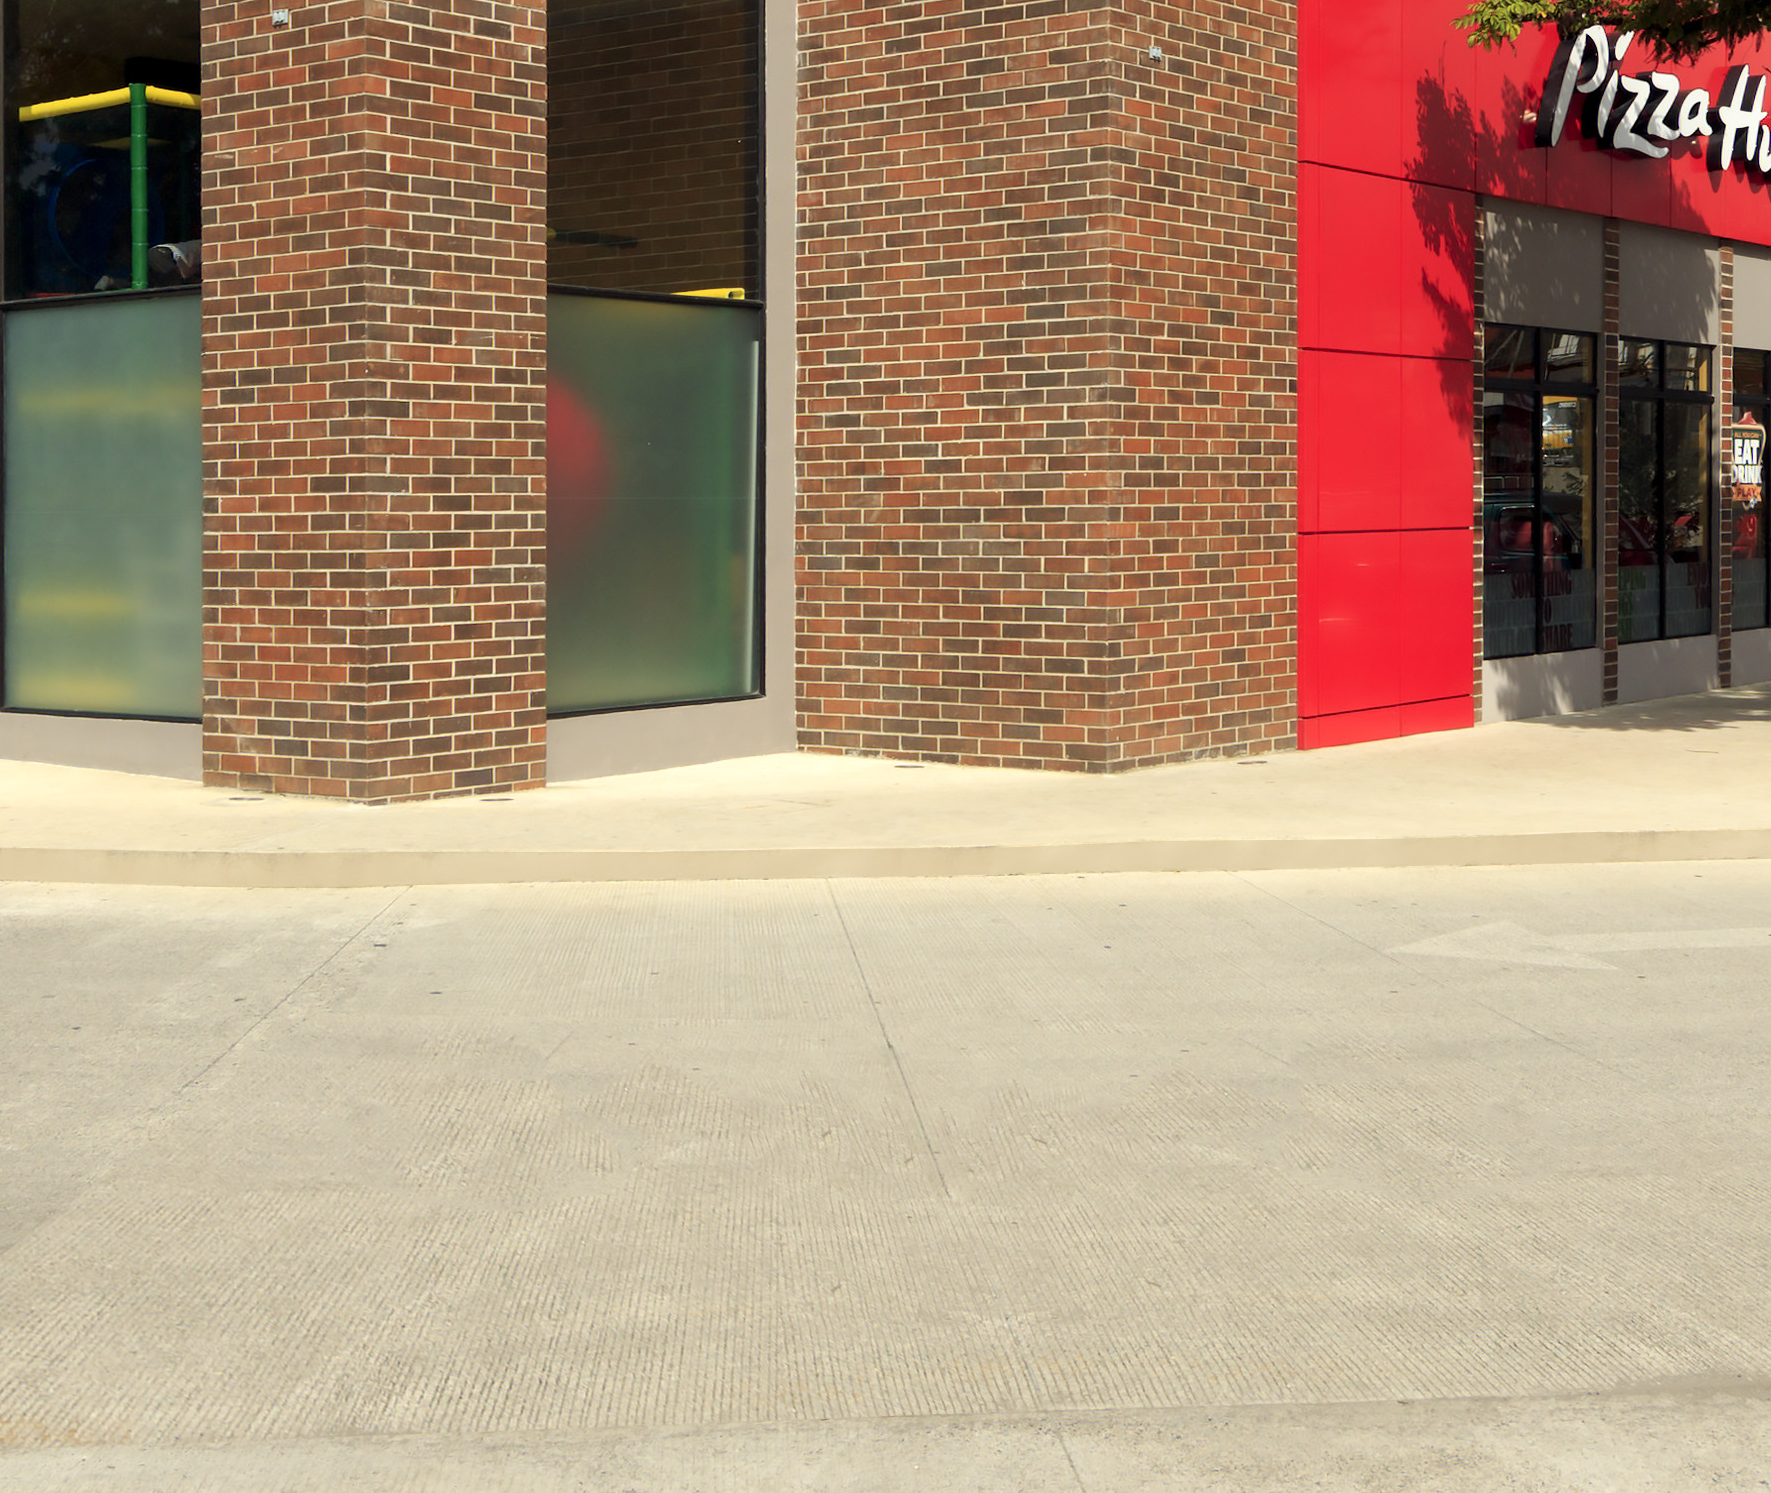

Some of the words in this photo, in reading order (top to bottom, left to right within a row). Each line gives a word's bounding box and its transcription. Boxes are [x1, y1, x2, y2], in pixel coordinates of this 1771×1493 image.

[1550, 24, 1713, 159] Pizza
[1734, 438, 1760, 465] EAT
[1730, 464, 1762, 484] DRINK
[1737, 487, 1757, 498] PLAY
